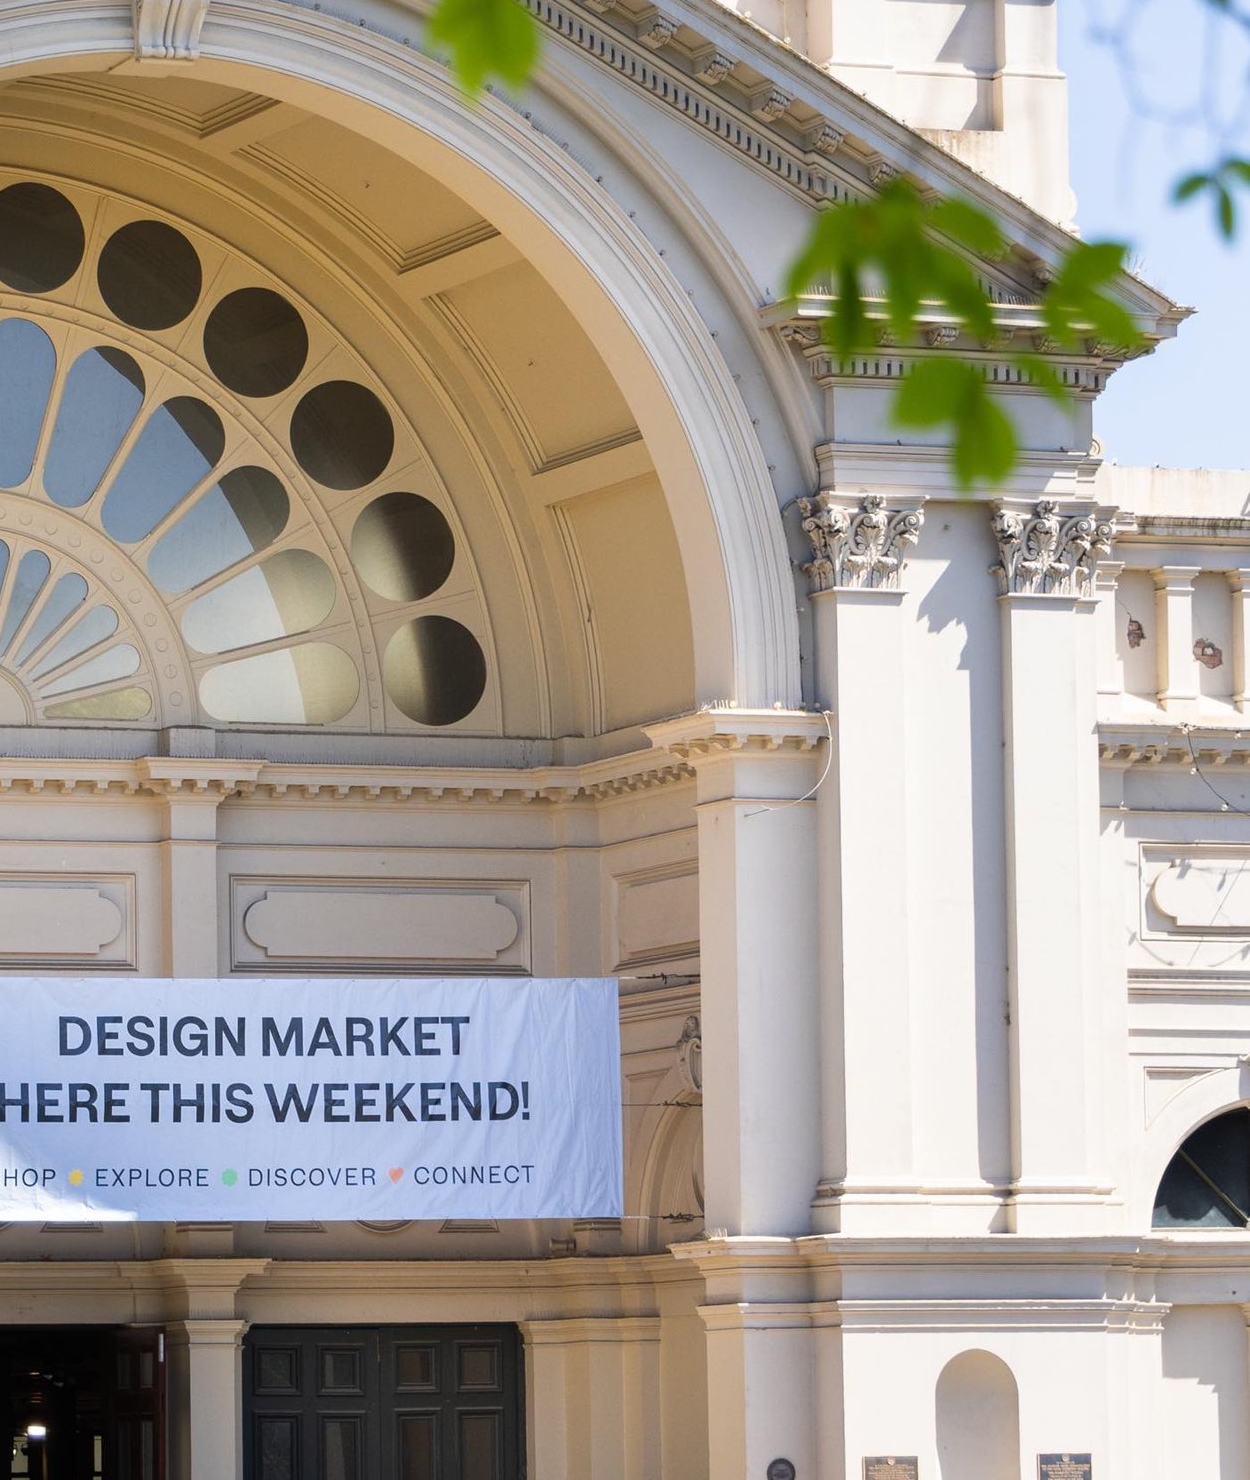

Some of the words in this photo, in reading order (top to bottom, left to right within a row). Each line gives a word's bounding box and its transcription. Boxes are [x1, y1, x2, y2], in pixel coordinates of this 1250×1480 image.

[58, 1015, 246, 1057] DESIGN
[261, 1016, 471, 1057] MARKET
[140, 1082, 255, 1123] THIS
[263, 1081, 531, 1123] WEEKEND!
[95, 1168, 210, 1188] EXPLORE
[248, 1167, 377, 1187] DISCOVER
[413, 1164, 536, 1185] CONNECT
